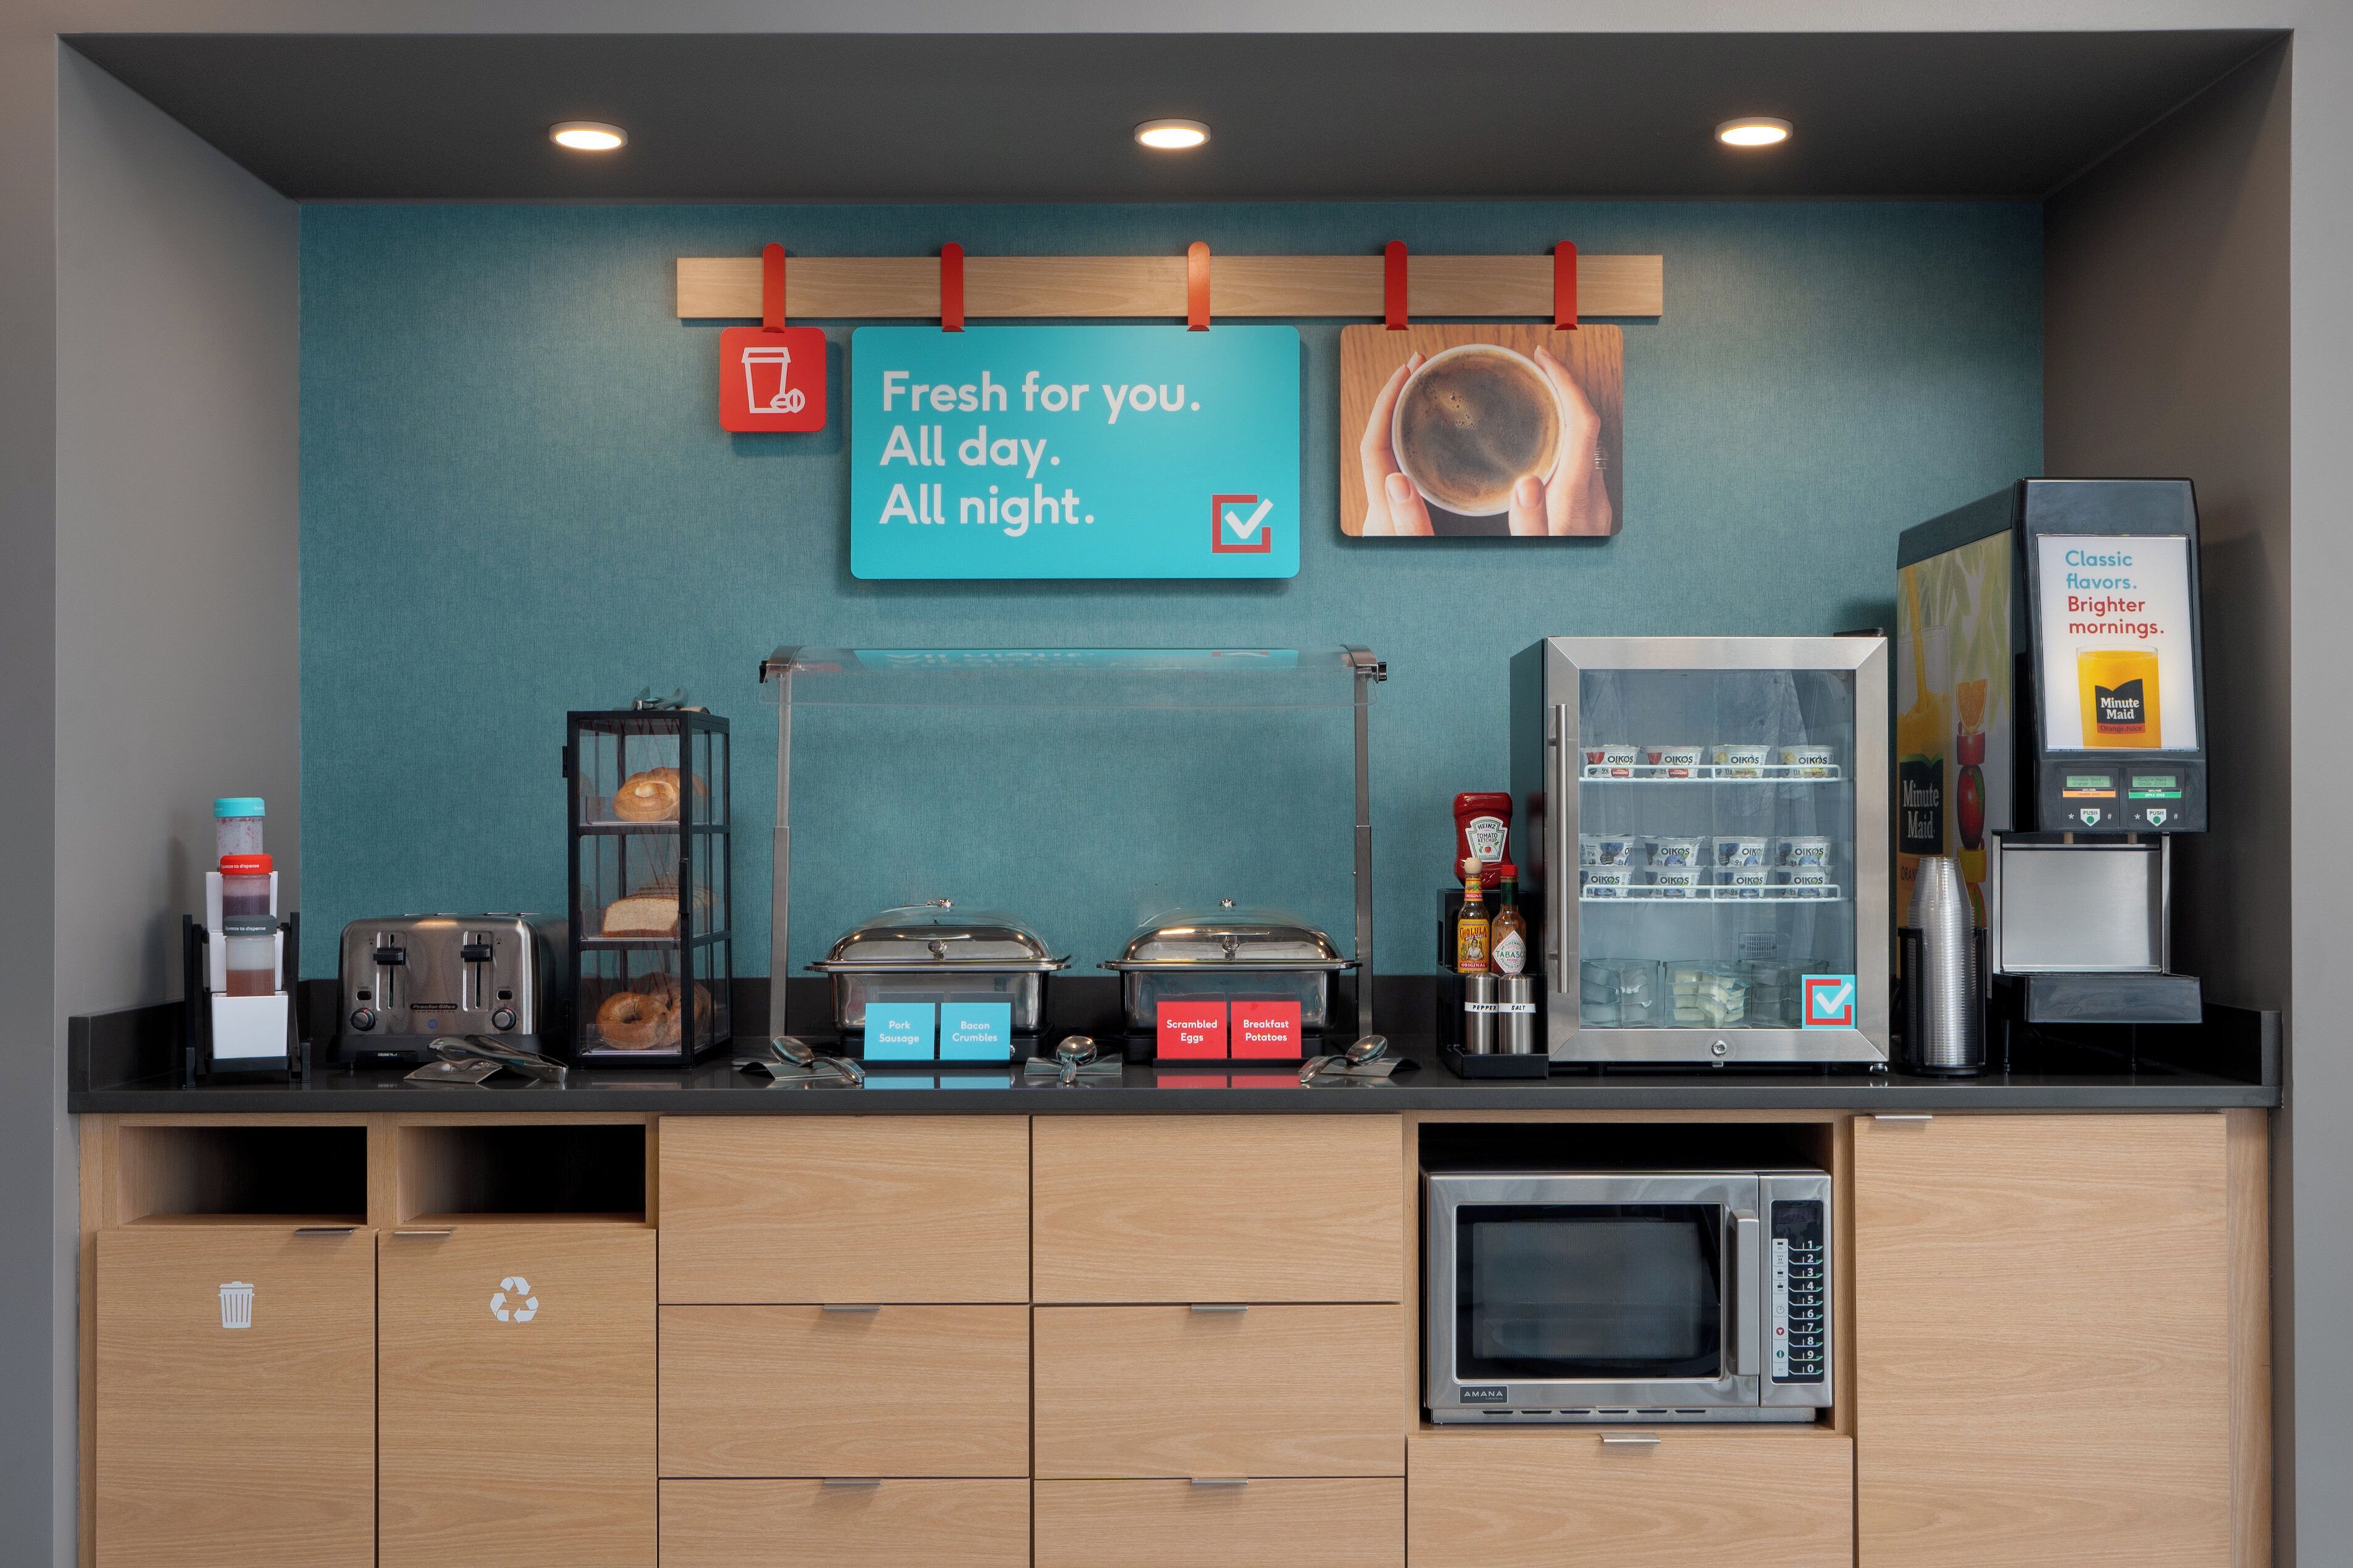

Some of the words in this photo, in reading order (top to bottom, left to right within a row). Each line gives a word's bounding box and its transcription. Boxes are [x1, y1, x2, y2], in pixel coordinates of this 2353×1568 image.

[883, 371, 1008, 412] Fresh
[1022, 371, 1090, 412] for
[1101, 384, 1201, 424] you.
[879, 425, 946, 466] All
[958, 425, 1061, 479] day.
[879, 484, 946, 524] All
[960, 484, 1095, 537] night.
[2065, 550, 2132, 567] Classic
[2066, 573, 2137, 589] flavors.
[2068, 595, 2146, 617] Brighter
[2069, 618, 2165, 639] mornings.
[2100, 697, 2140, 708] Minute
[2106, 709, 2135, 719] Maid
[1607, 755, 1633, 763] OIKOS
[1664, 755, 1693, 763] OIKOS
[1731, 756, 1759, 764] OIKOS
[1798, 757, 1827, 765] OIKOS
[1903, 779, 1939, 807] Minute
[1907, 811, 1934, 839] Maid
[1795, 848, 1824, 856] OIKOS
[1901, 866, 1917, 881] ORAN
[1591, 876, 1620, 884] OIKOS
[1460, 926, 1487, 940] CHOLULA
[888, 1021, 911, 1029] Pork
[961, 1021, 990, 1029] Bacon
[1166, 1019, 1218, 1029] Scrambled
[1243, 1019, 1289, 1029] Breakfast
[879, 1034, 919, 1045] Sausage
[952, 1033, 998, 1042] Crumbles
[1181, 1033, 1203, 1044] Eggs
[1245, 1032, 1287, 1041] Potatoes
[1808, 1241, 1812, 1249] 1
[1808, 1254, 1814, 1262] 2
[1808, 1268, 1814, 1277] 3
[1808, 1282, 1814, 1290] 4
[1808, 1296, 1814, 1304] 5
[1808, 1309, 1814, 1318] 6
[1808, 1323, 1814, 1331] 7
[1808, 1337, 1814, 1345] 8
[1808, 1351, 1814, 1359] 9
[1808, 1364, 1814, 1373] 0
